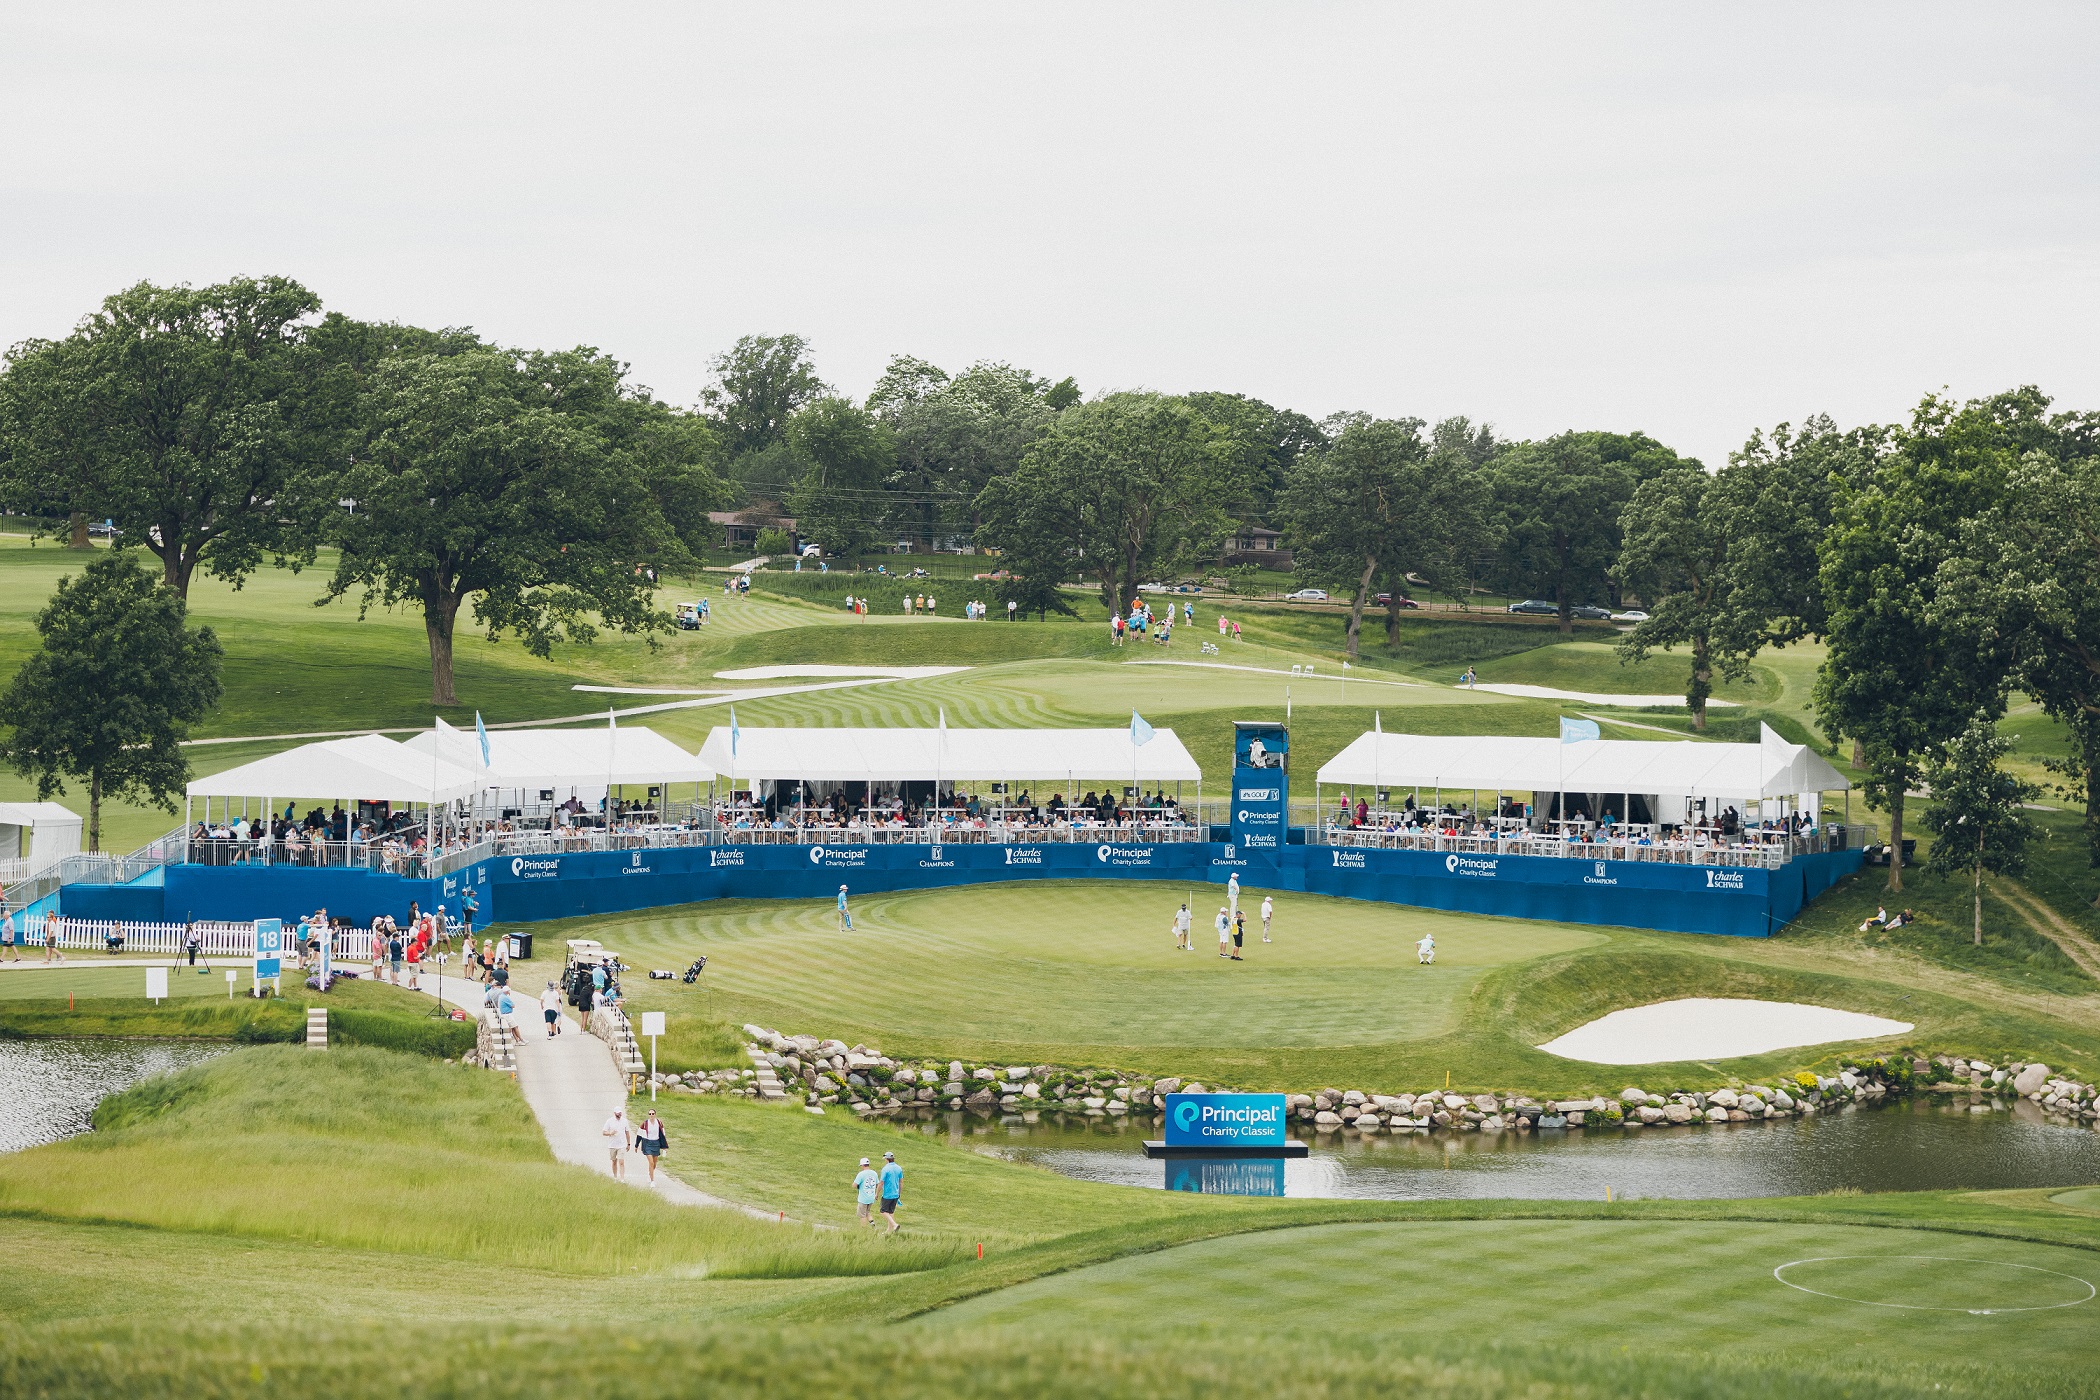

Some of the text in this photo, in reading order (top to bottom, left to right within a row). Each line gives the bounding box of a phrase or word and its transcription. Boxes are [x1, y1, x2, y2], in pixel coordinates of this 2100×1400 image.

[1249, 812, 1279, 820] Principal
[1251, 834, 1276, 842] charles
[716, 849, 744, 859] charles
[826, 849, 866, 861] Principal
[1013, 848, 1042, 857] charles
[1112, 848, 1151, 859] Principal
[1339, 851, 1365, 862] charles
[524, 859, 558, 871] Principal
[716, 858, 744, 866] SCHWAB
[1212, 858, 1247, 866] CHAMPIONS
[1339, 860, 1365, 868] SCHWAB
[1460, 858, 1496, 871] Principal
[622, 866, 650, 874] CHAMPIONS
[1459, 869, 1478, 877] Charity
[1584, 875, 1617, 884] CHAMPIONS
[1714, 871, 1744, 882] charles
[1714, 880, 1743, 889] SCHWAB
[260, 931, 278, 948] 18
[1203, 1106, 1277, 1125] Principal
[1202, 1126, 1275, 1138] Charity Classic
